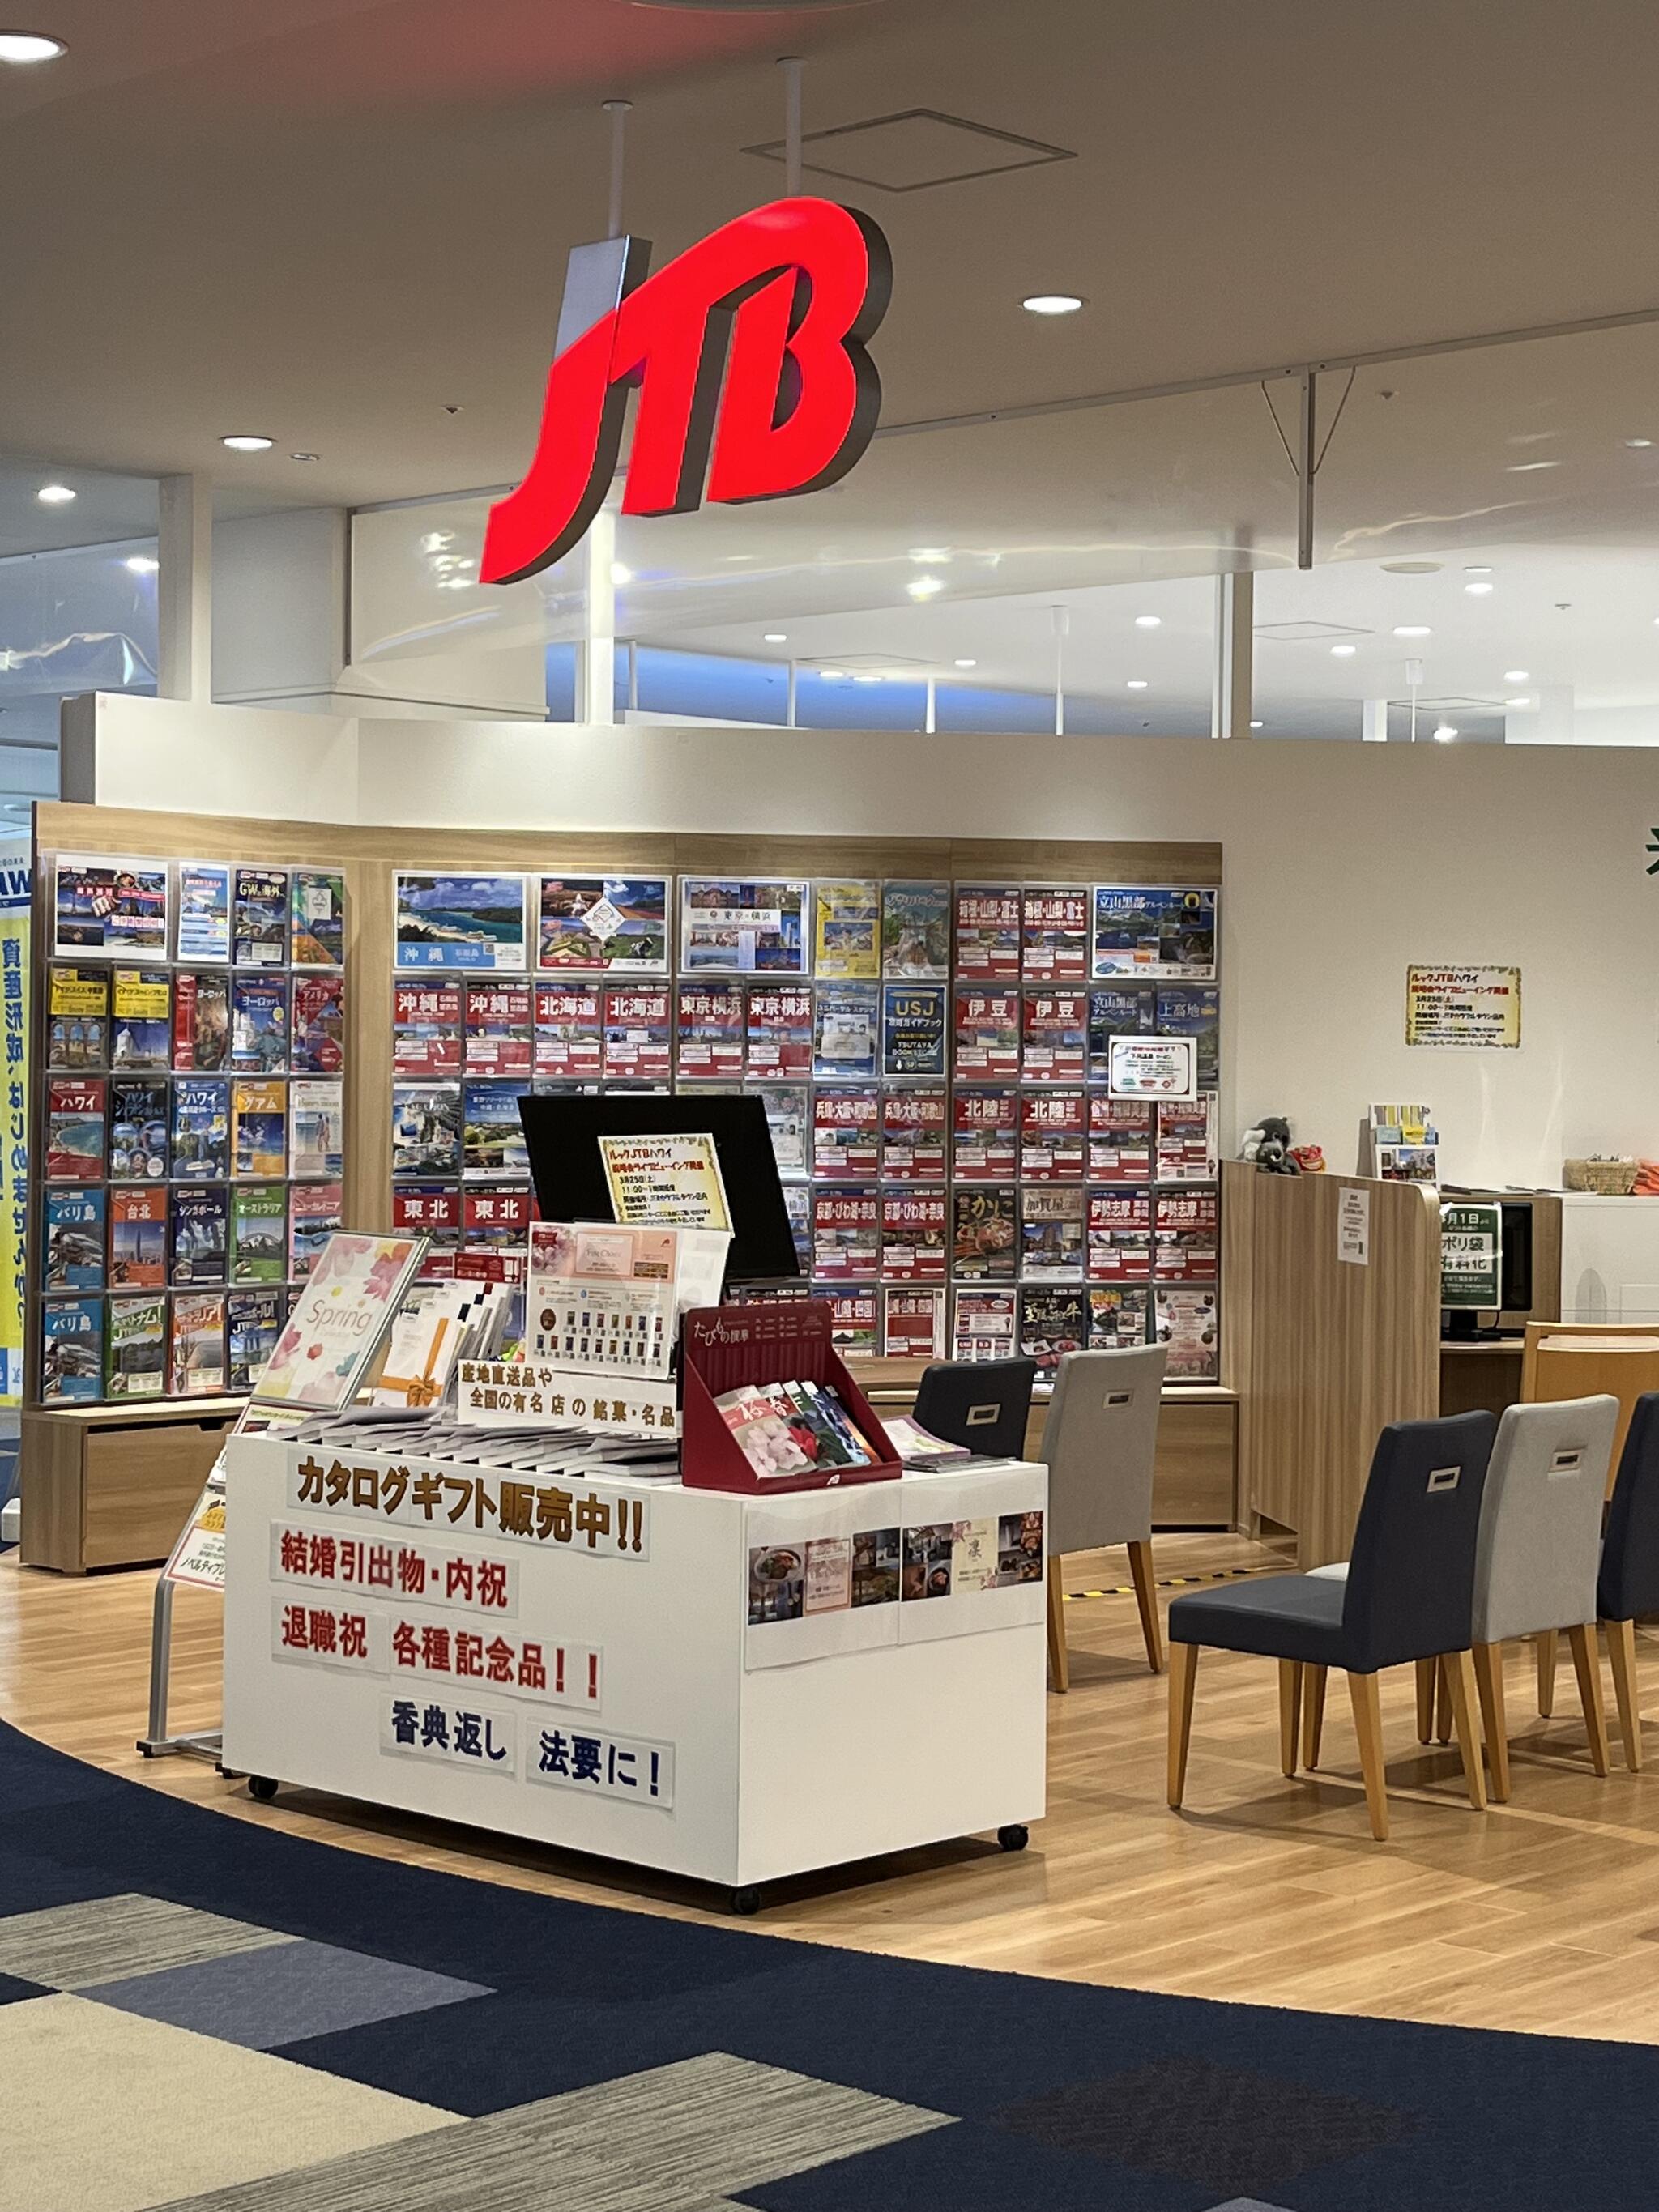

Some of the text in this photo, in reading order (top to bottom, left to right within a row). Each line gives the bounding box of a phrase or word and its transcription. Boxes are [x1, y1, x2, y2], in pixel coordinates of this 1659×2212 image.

[479, 196, 883, 584] JTB
[1411, 974, 1479, 983] ルックJTBハワイ
[197, 988, 227, 999] ヨーロッパ
[242, 996, 279, 1007] ヨーロッパ
[303, 991, 329, 1002] アメリカ
[398, 993, 438, 1012] 沖縄
[470, 995, 509, 1013] 沖縄
[539, 996, 597, 1017] 北海道
[610, 997, 667, 1017] 北海道
[896, 1001, 933, 1016] USJ
[968, 999, 1008, 1017] 伊豆
[1035, 1000, 1075, 1019] 伊豆
[1160, 1002, 1200, 1017] 上高地
[60, 1095, 96, 1110] ハワイ
[126, 1092, 154, 1104] ハワイ
[186, 1092, 219, 1105] ハワイ
[244, 1097, 277, 1110] グアム
[964, 1099, 1000, 1118] 北陸
[1030, 1101, 1065, 1119] 北陸
[609, 1148, 672, 1160] ルックJTBハワイ
[57, 1205, 96, 1221] バリ島
[127, 1204, 151, 1220] 台北
[179, 1204, 222, 1216] シンガポール
[238, 1203, 282, 1214] オーストラリア
[404, 1200, 449, 1219] 東北
[474, 1200, 519, 1219] 東北
[817, 1201, 877, 1221] 京都・びわ湖・奈良
[884, 1202, 945, 1221] 京都・びわ湖・奈良
[1091, 1200, 1131, 1218] 伊勢志摩
[1158, 1200, 1197, 1218] 伊勢志摩
[1442, 1236, 1485, 1251] ポリ袋
[52, 1315, 91, 1332] バリ島
[306, 1299, 373, 1336] Spring
[461, 1362, 552, 1387] 産地直送品や
[470, 1387, 675, 1427] 全国の有名店の銘菓・名品
[297, 1455, 644, 1553] カタログギフト販売中!!
[280, 1530, 508, 1608] 結婚引出物・内祝
[281, 1605, 598, 1699] 退職祝 各種記念品!!
[392, 1701, 659, 1797] 香典返し 法要に!
